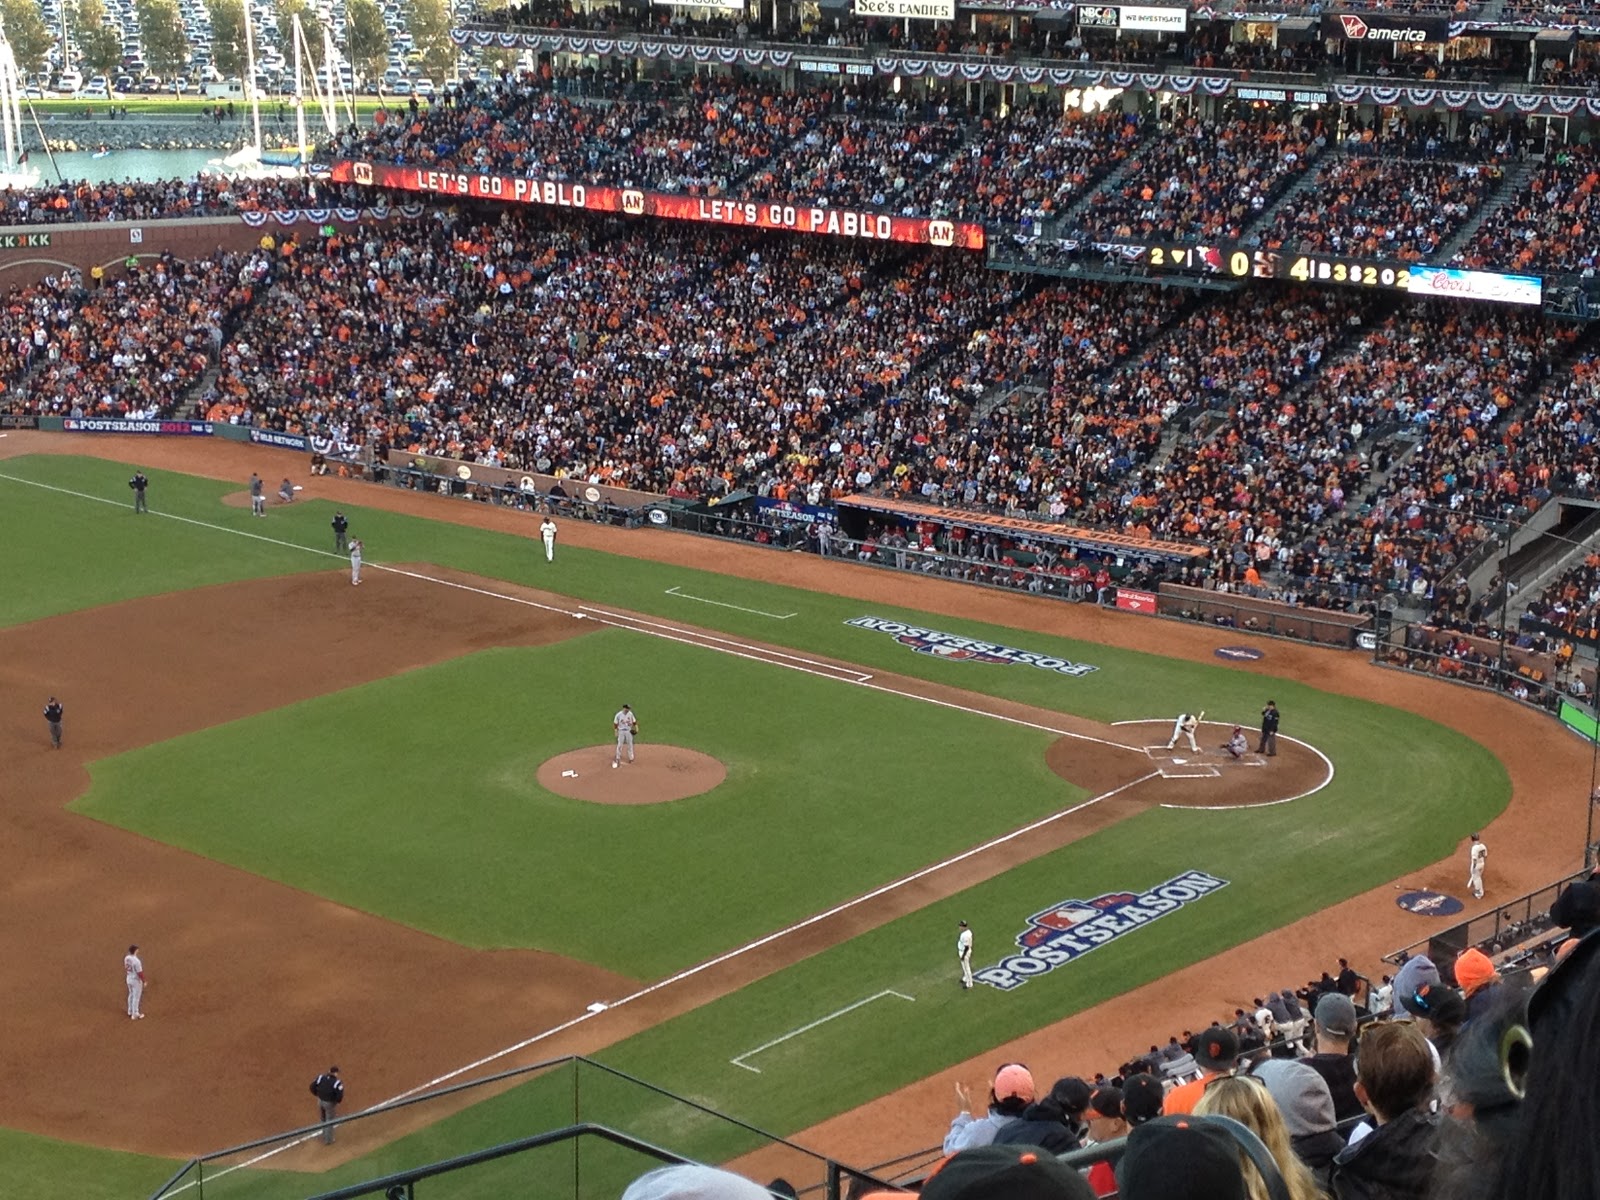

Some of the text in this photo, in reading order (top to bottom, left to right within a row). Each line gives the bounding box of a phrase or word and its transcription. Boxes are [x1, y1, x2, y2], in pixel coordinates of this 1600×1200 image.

[899, 3, 949, 16] CANDIES
[1080, 7, 1103, 17] NBC
[1367, 27, 1427, 41] america
[417, 169, 586, 208] LET'S GO PABLO
[700, 199, 891, 240] LET'S GO PABLO
[1151, 247, 1164, 265] 2
[1230, 251, 1249, 276] 0
[1290, 257, 1309, 281] 4
[80, 420, 160, 432] POSTSEASON
[161, 422, 190, 433] 2012
[852, 616, 1093, 676] POSTSEASON
[977, 872, 1222, 990] POSTSEASON
